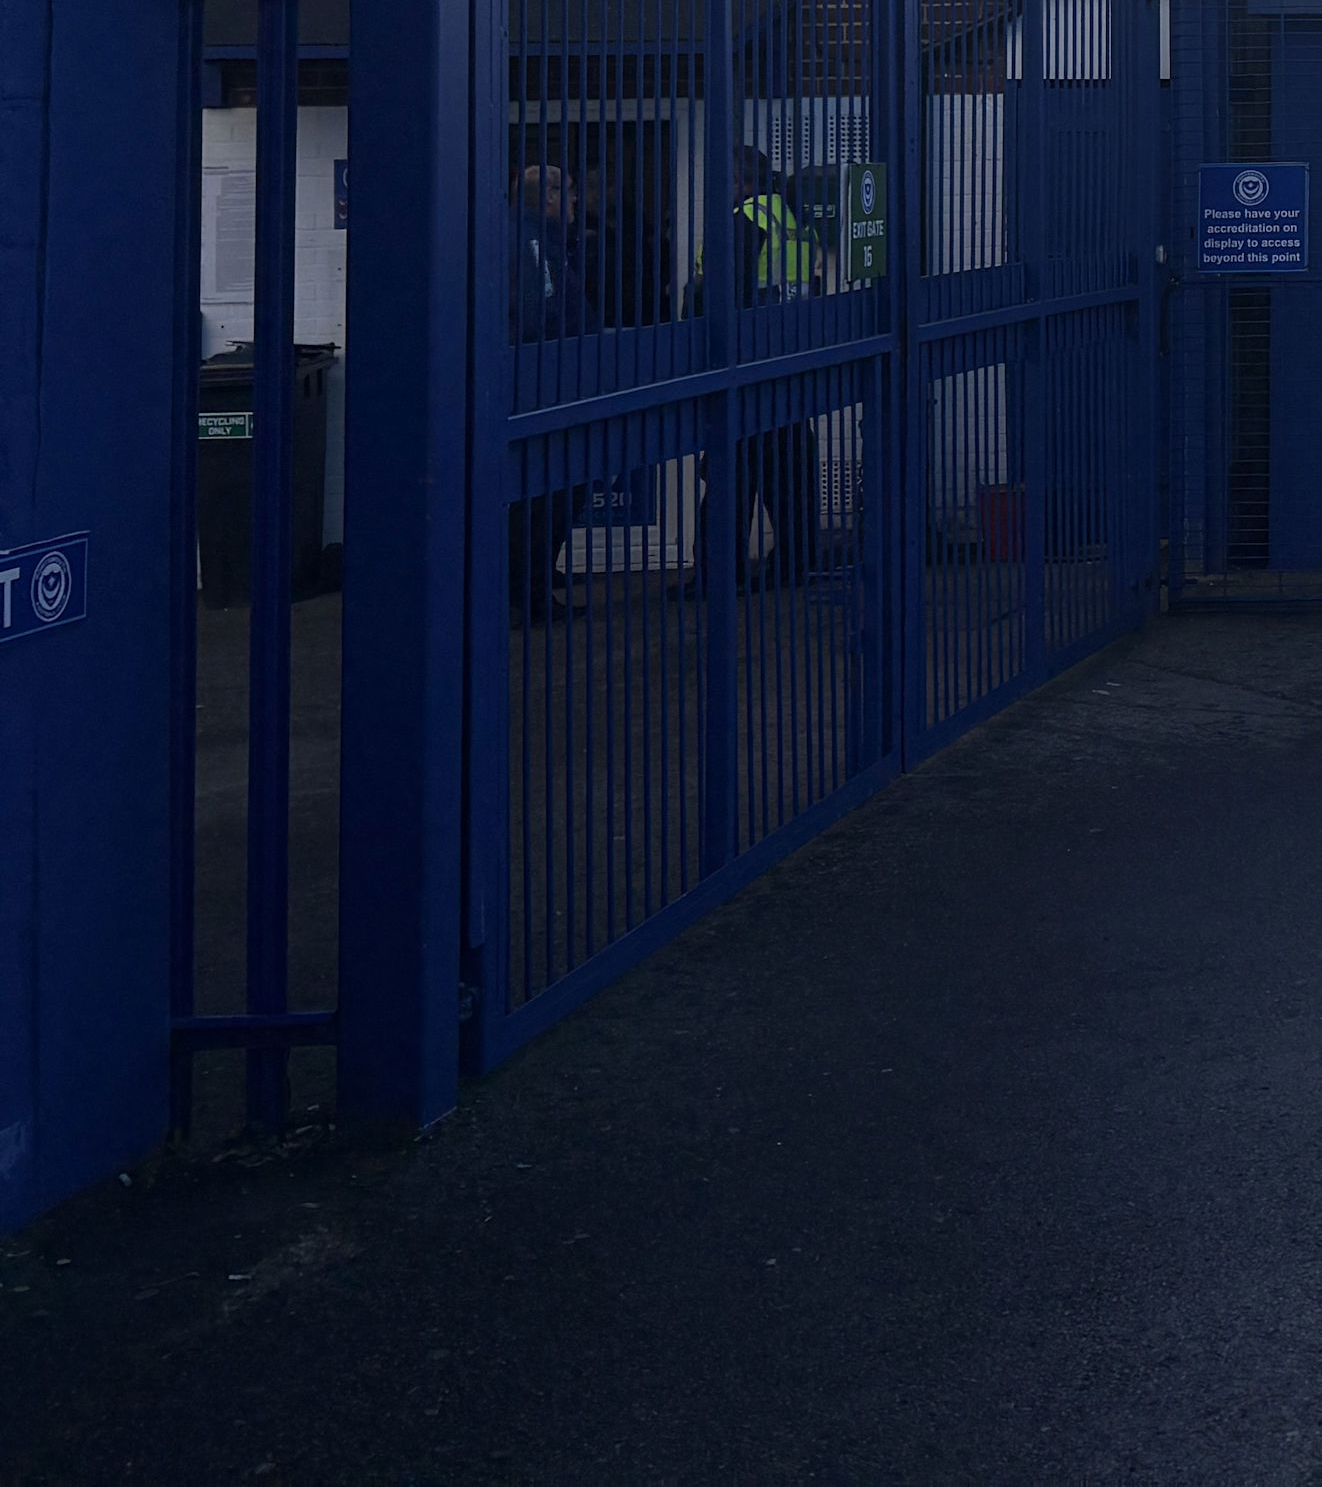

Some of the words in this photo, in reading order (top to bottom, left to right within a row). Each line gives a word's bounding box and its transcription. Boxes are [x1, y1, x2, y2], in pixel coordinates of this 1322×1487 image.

[1204, 208, 1242, 219] Please
[1244, 208, 1271, 218] have
[1274, 210, 1300, 220] your
[852, 221, 867, 239] EXIT
[867, 219, 884, 237] GATE
[1207, 223, 1280, 233] accreditation
[1283, 224, 1298, 232] on
[1204, 237, 1244, 250] display
[1247, 238, 1258, 247] to
[1261, 239, 1300, 248] access
[1203, 252, 1245, 265] beyond
[1247, 252, 1269, 262] this
[1271, 252, 1301, 264] point
[208, 426, 232, 435] ONLY
